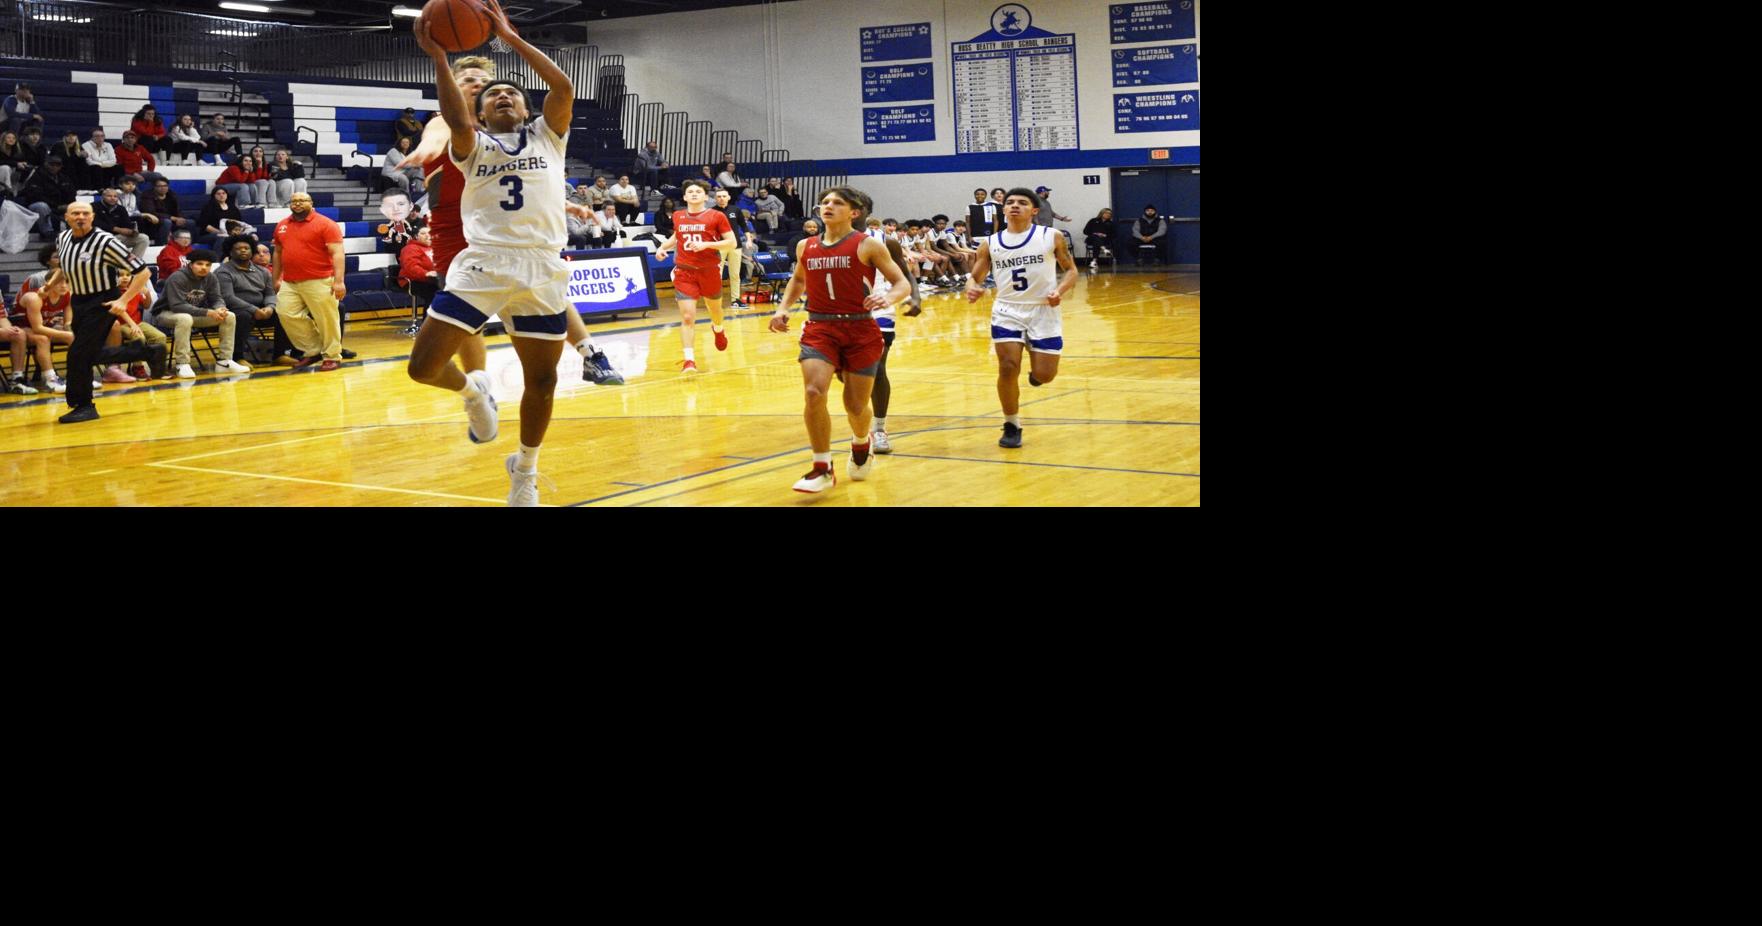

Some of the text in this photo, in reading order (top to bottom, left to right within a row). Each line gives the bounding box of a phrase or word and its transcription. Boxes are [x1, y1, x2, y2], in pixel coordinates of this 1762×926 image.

[1134, 4, 1169, 12] BASEBALL
[1131, 9, 1172, 18] CHAMPIONS
[878, 31, 913, 39] CHAMPIONS
[1001, 41, 1014, 49] HIGH
[1019, 40, 1038, 48] SCHOOL
[1044, 37, 1068, 45] RANGERS
[1137, 48, 1170, 56] SOFTBALL
[1133, 53, 1174, 61] CHAMPIONS
[1136, 94, 1175, 102] WRESTLING
[1135, 100, 1176, 108] CHAMPIONS
[1153, 150, 1167, 159] EXIT
[475, 156, 548, 177] RANGERS
[1087, 176, 1098, 184] 11
[498, 175, 524, 211] 3
[679, 224, 706, 232] CONSTANTINE
[807, 255, 851, 271] CONSTANTINE
[995, 254, 1044, 270] RANGERS
[1011, 268, 1029, 292] 5
[825, 273, 835, 300] 1
